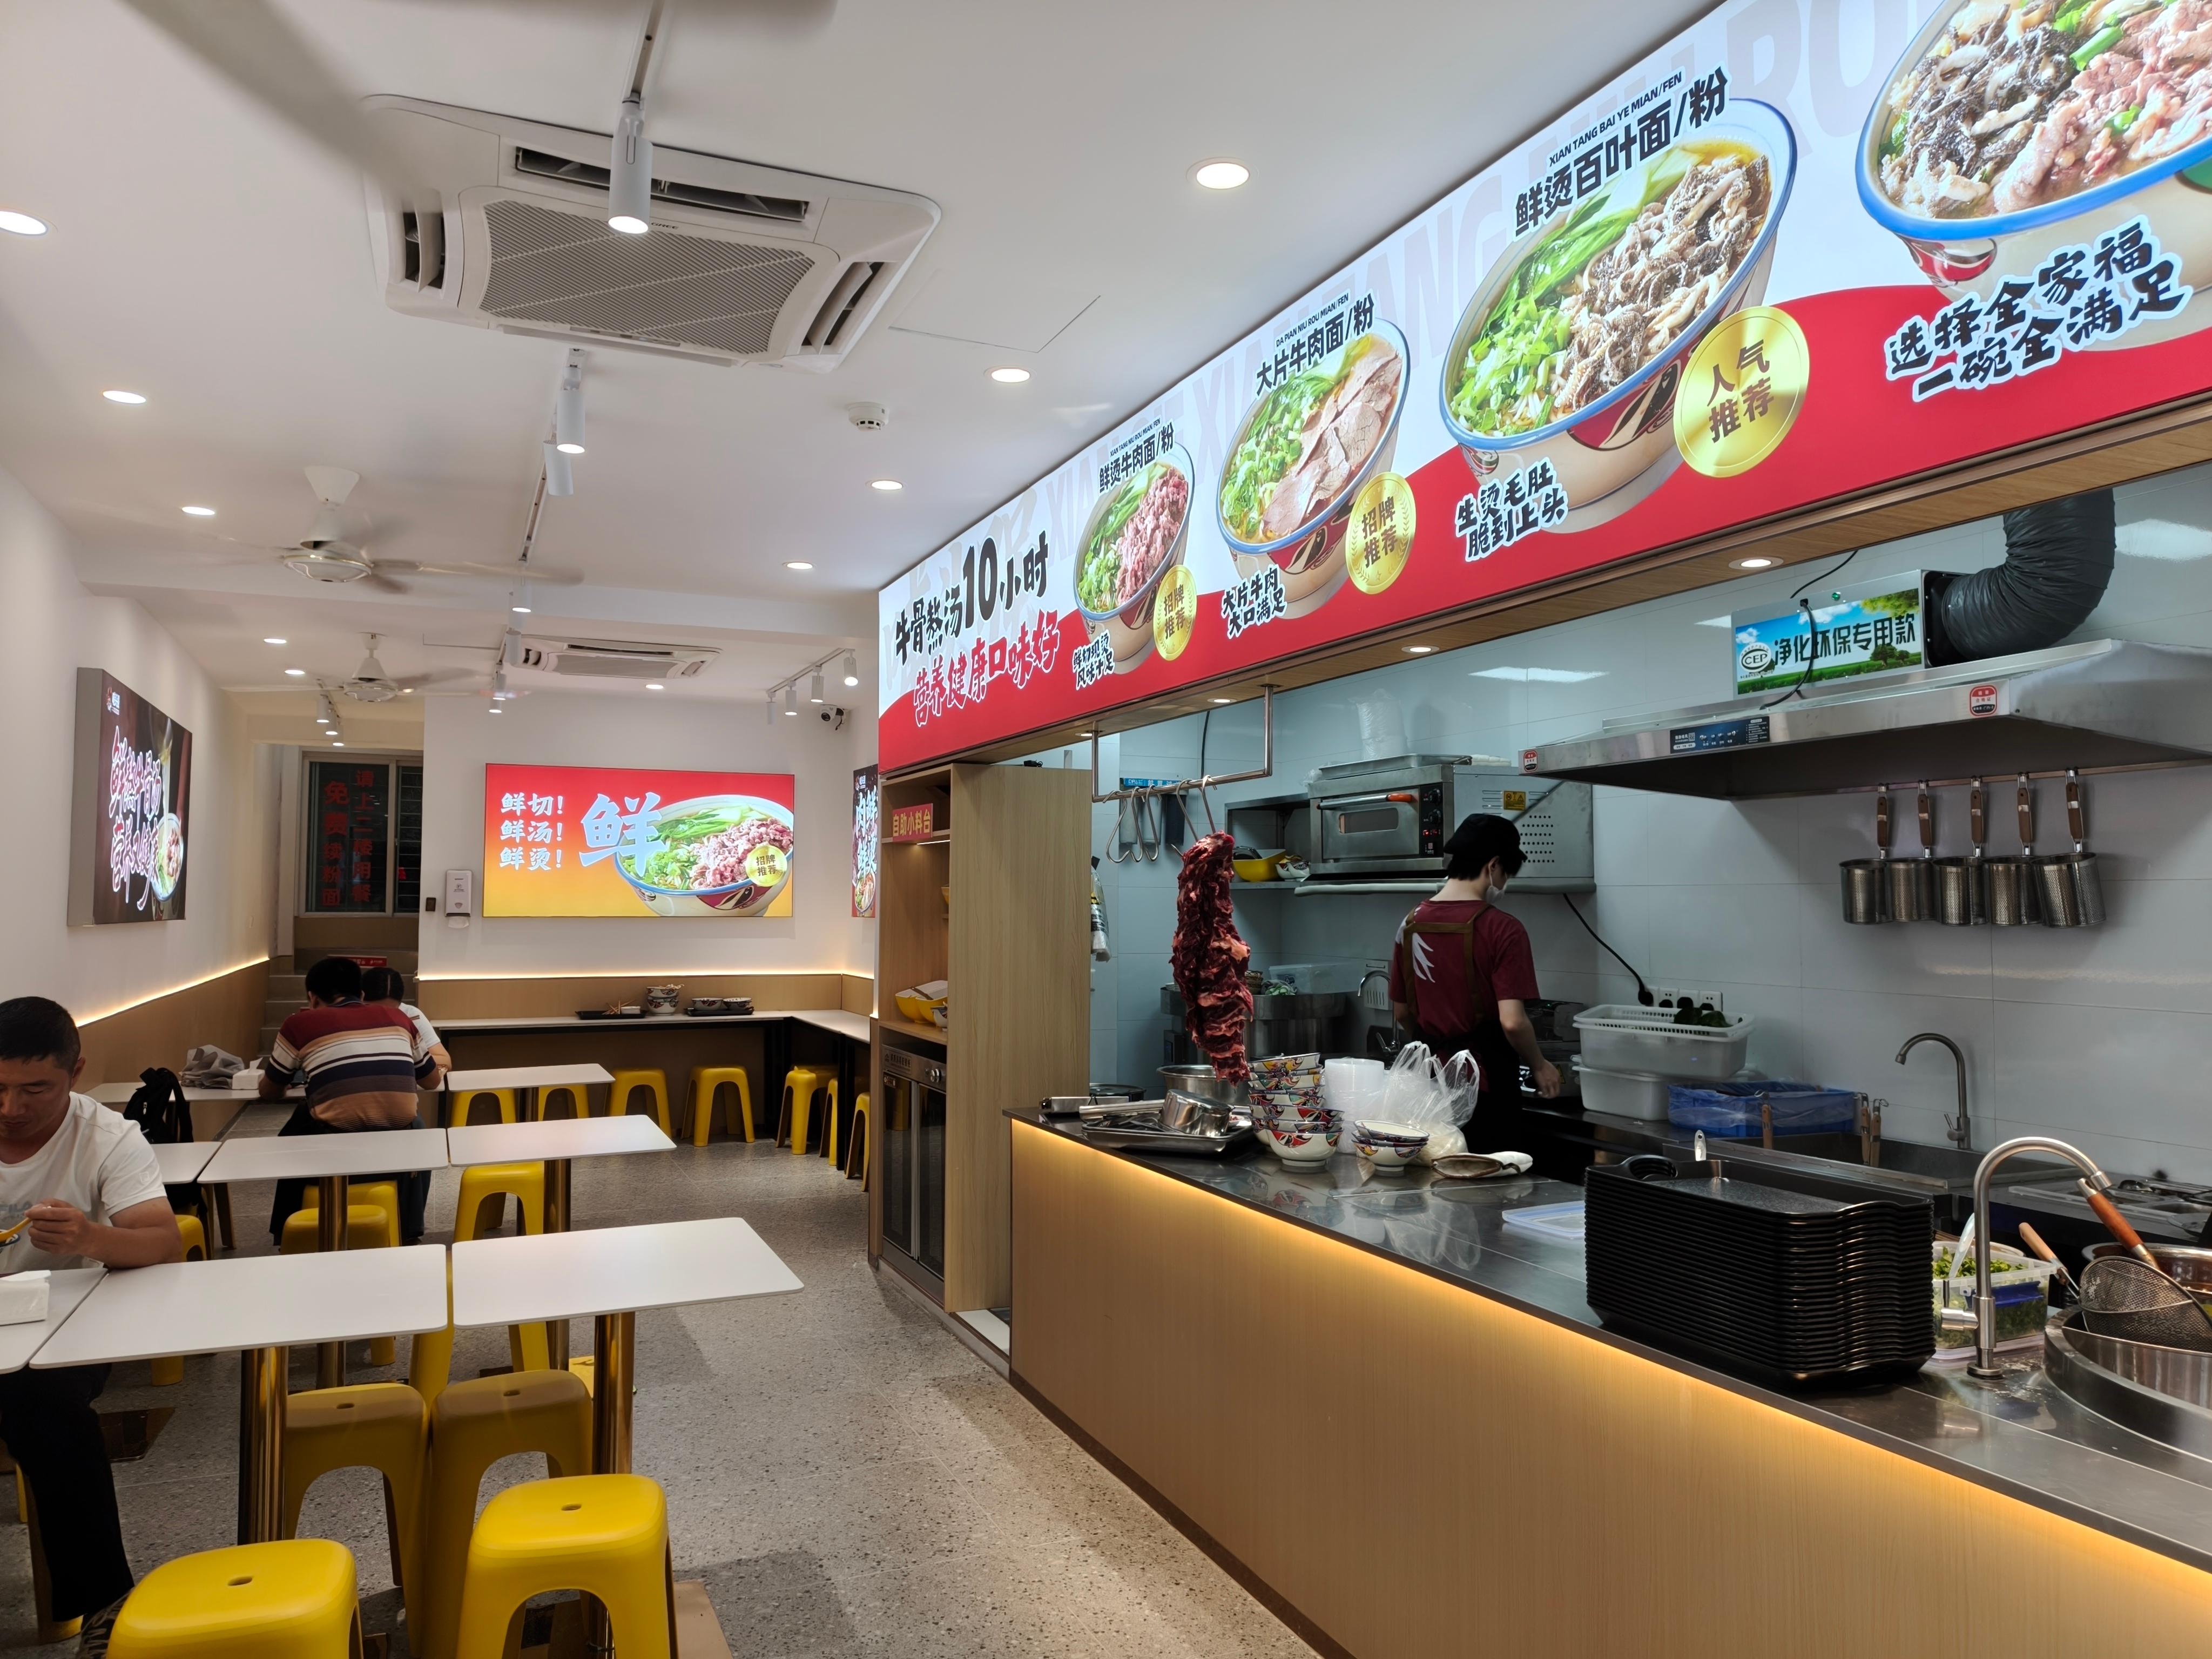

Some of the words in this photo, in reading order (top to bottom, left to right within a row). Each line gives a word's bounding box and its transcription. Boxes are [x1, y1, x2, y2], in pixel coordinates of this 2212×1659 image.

[1549, 143, 1571, 167] XIAN
[1573, 126, 1597, 150] TANG
[1600, 114, 1615, 133] BAI
[1617, 106, 1629, 121] YE
[1631, 71, 1682, 113] MIAN/FEN
[1516, 66, 1728, 238] 鲜烫百叶面/粉
[1890, 222, 2153, 374] 选择全家福
[1256, 293, 1374, 396] 大片牛肉面/粉
[1276, 337, 1284, 347] DA
[1284, 327, 1297, 342] PIAN
[1297, 320, 1307, 334] NIU
[1308, 313, 1319, 326] ROU
[1918, 259, 2185, 396] 一碗全满足
[1707, 339, 1770, 407] 人气
[1709, 376, 1774, 443] 推荐
[1100, 422, 1174, 493] 鲜烫牛肉面/粉
[1110, 447, 1118, 457] XIAN
[1118, 441, 1128, 451] TANG
[1135, 430, 1143, 441] ROU
[1361, 496, 1395, 540] 招牌
[1458, 462, 1553, 533] 生烫毛肚
[1364, 524, 1398, 569] 推荐
[1468, 488, 1565, 558] 脆到上头
[896, 529, 1049, 666] 牛骨熬汤10小时
[1164, 584, 1184, 617] 招牌
[1223, 568, 1278, 615] 大片牛肉
[1230, 587, 1285, 636] 大口满足
[1165, 607, 1185, 639] 推荐
[1774, 613, 1916, 665] 净化环保专用款
[913, 609, 1060, 727] 营养健康口味好
[1074, 633, 1109, 670] 鲜切现烫
[1077, 651, 1114, 687] 风味十足
[1745, 653, 1768, 665] CEP
[579, 792, 669, 877] 鲜
[893, 809, 930, 837] 自助小料台
[756, 854, 775, 866] 招牌
[757, 865, 777, 876] 推荐
